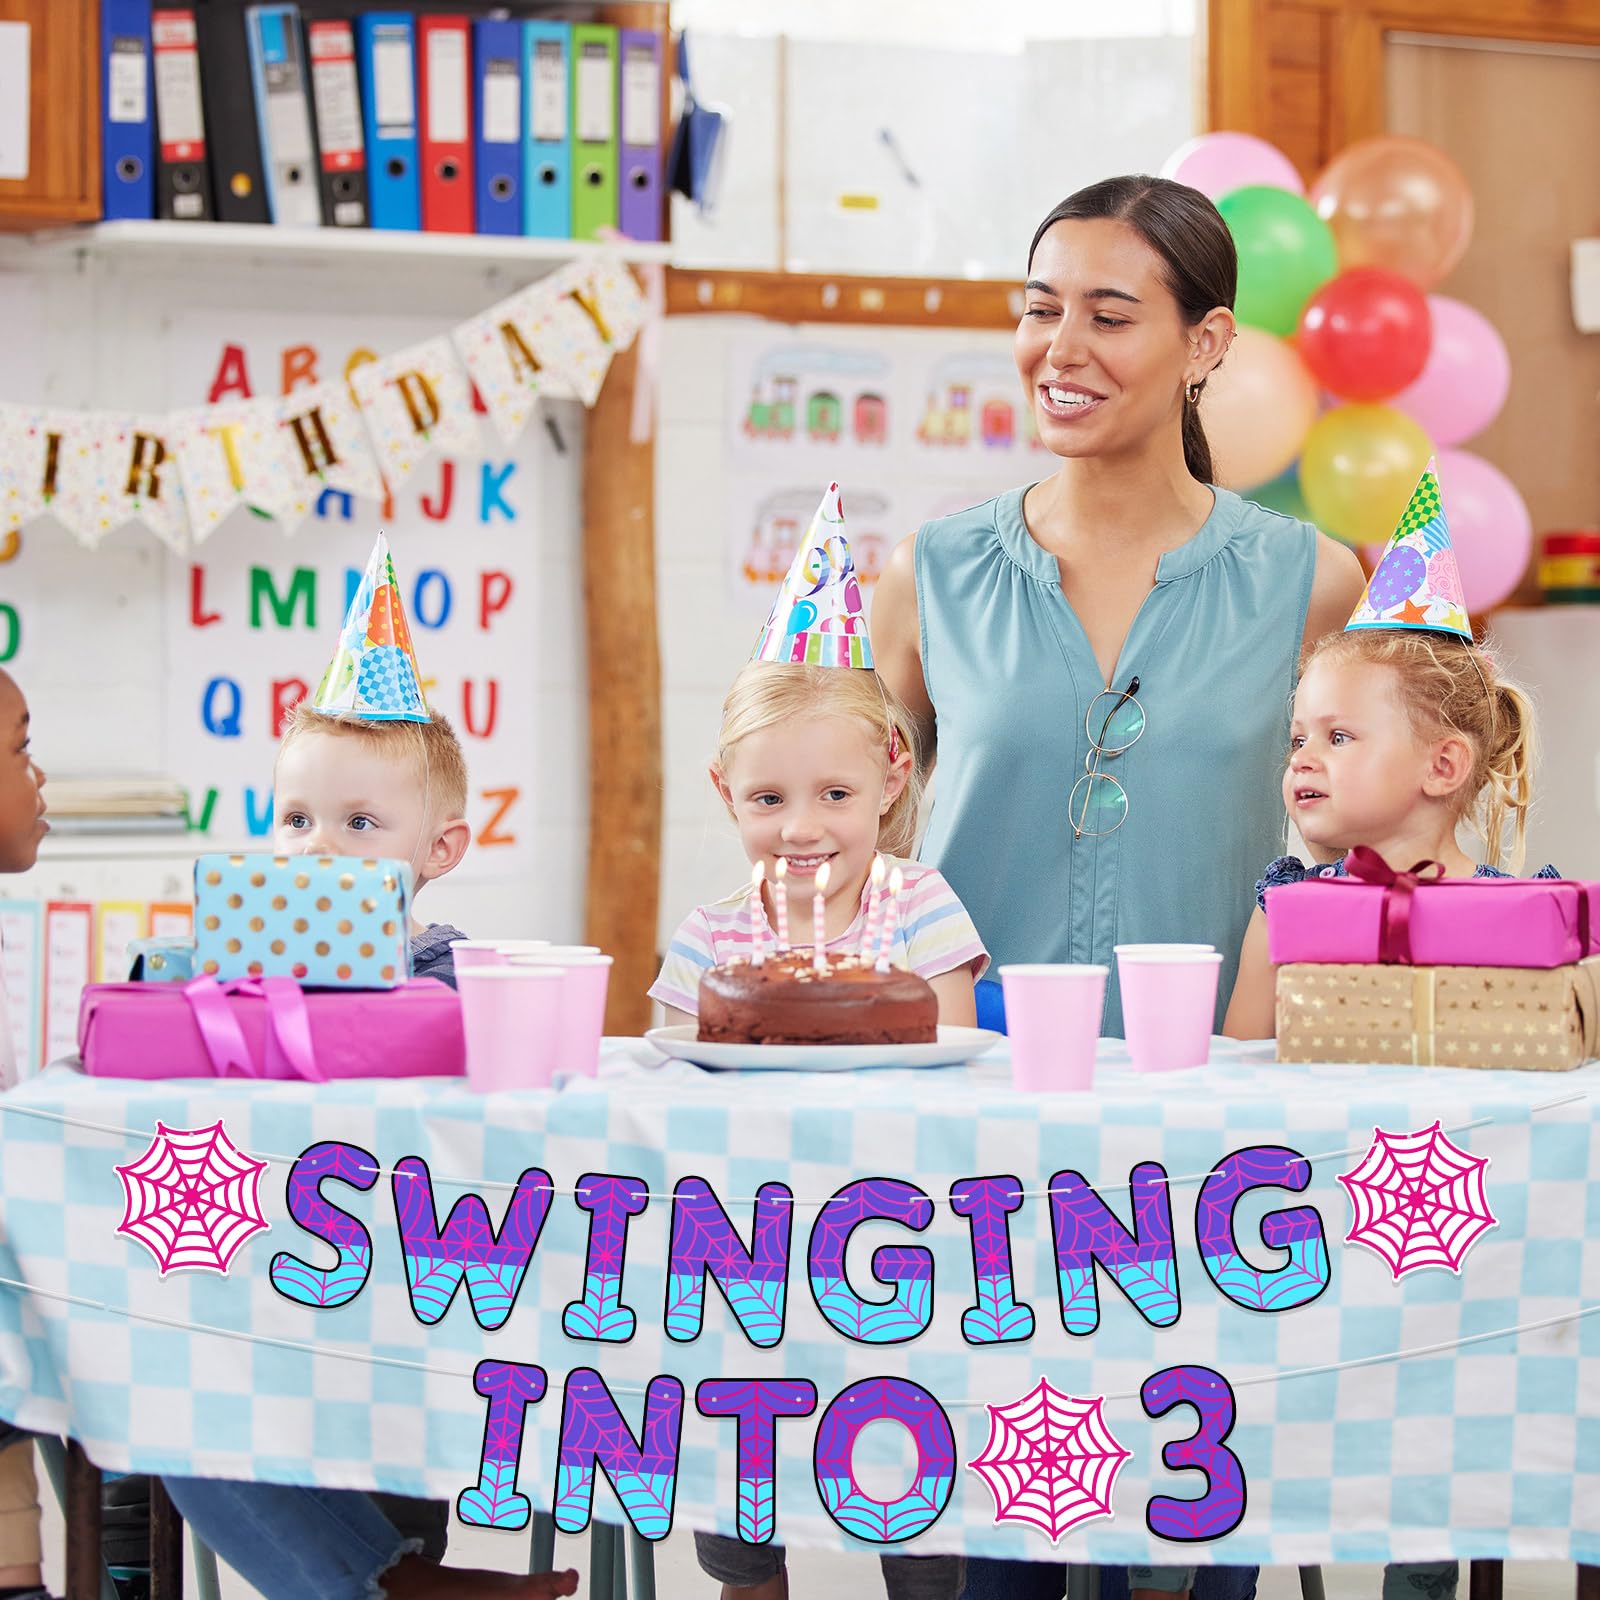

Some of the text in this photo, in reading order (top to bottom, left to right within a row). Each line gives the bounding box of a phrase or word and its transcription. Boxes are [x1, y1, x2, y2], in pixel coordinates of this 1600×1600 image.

[207, 342, 252, 403] A
[420, 458, 455, 521] J
[479, 460, 517, 523] K
[189, 563, 222, 628] L
[249, 566, 317, 629] M
[411, 569, 451, 629] O
[478, 570, 512, 630] P
[200, 675, 242, 738] Q
[461, 680, 498, 739] U
[475, 786, 521, 846] Z
[268, 1140, 1332, 1347] SWINGING
[455, 1358, 1248, 1544] INTO 3
